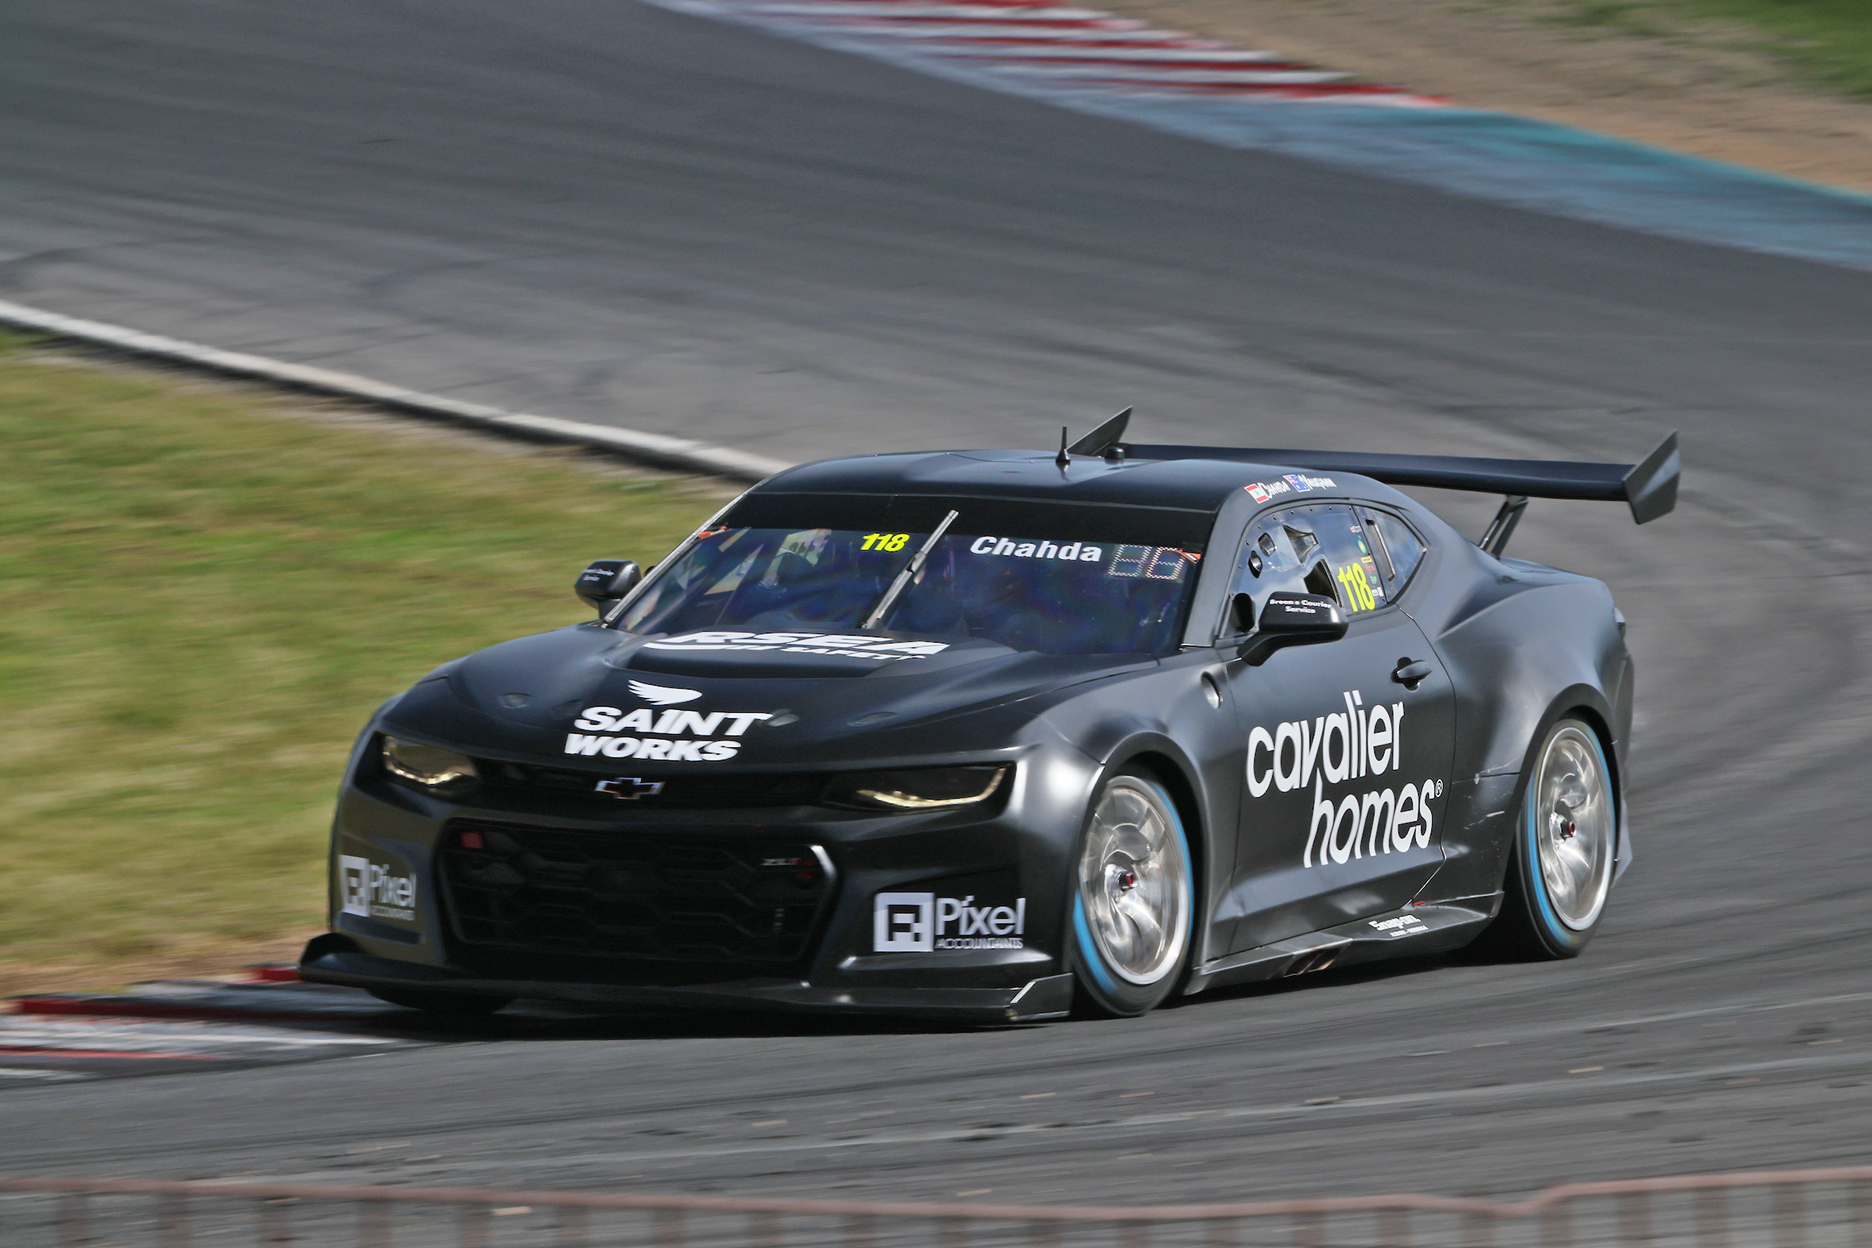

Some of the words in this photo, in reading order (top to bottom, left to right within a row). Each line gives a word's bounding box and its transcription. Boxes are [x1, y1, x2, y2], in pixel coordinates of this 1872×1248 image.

[860, 533, 909, 552] 118
[970, 536, 1102, 562] Chahda
[1338, 563, 1375, 612] 118
[656, 631, 950, 655] RSEA
[574, 706, 774, 736] SAINT
[564, 734, 742, 762] WORKS
[1247, 690, 1404, 798] cavalier
[370, 864, 417, 908] Pixel
[935, 895, 1026, 936] Pixel
[934, 937, 1024, 950] ACCOUNTANTS
